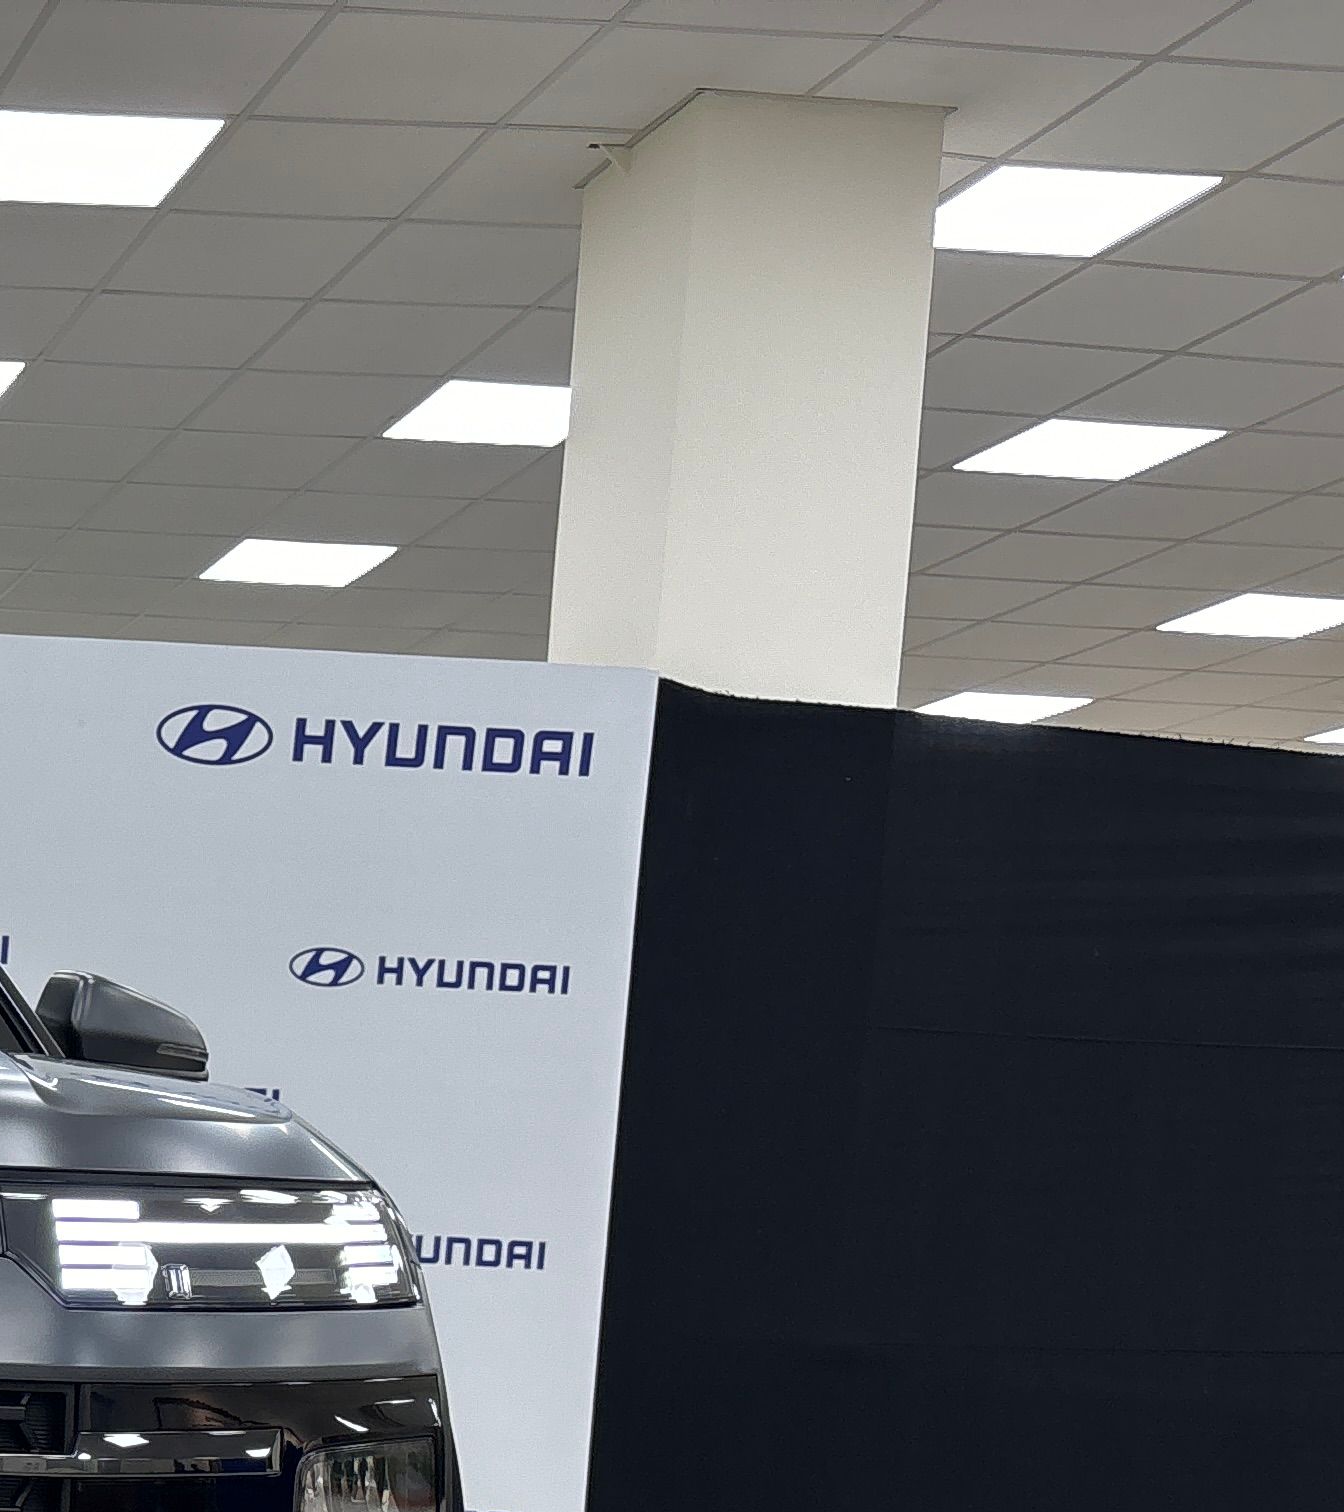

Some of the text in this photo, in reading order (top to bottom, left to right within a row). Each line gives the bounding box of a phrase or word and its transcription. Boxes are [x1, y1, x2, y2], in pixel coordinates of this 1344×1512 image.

[292, 717, 595, 777] HYUNDAI
[376, 955, 571, 995] HYUNDAI
[415, 1235, 546, 1270] UNDAI
